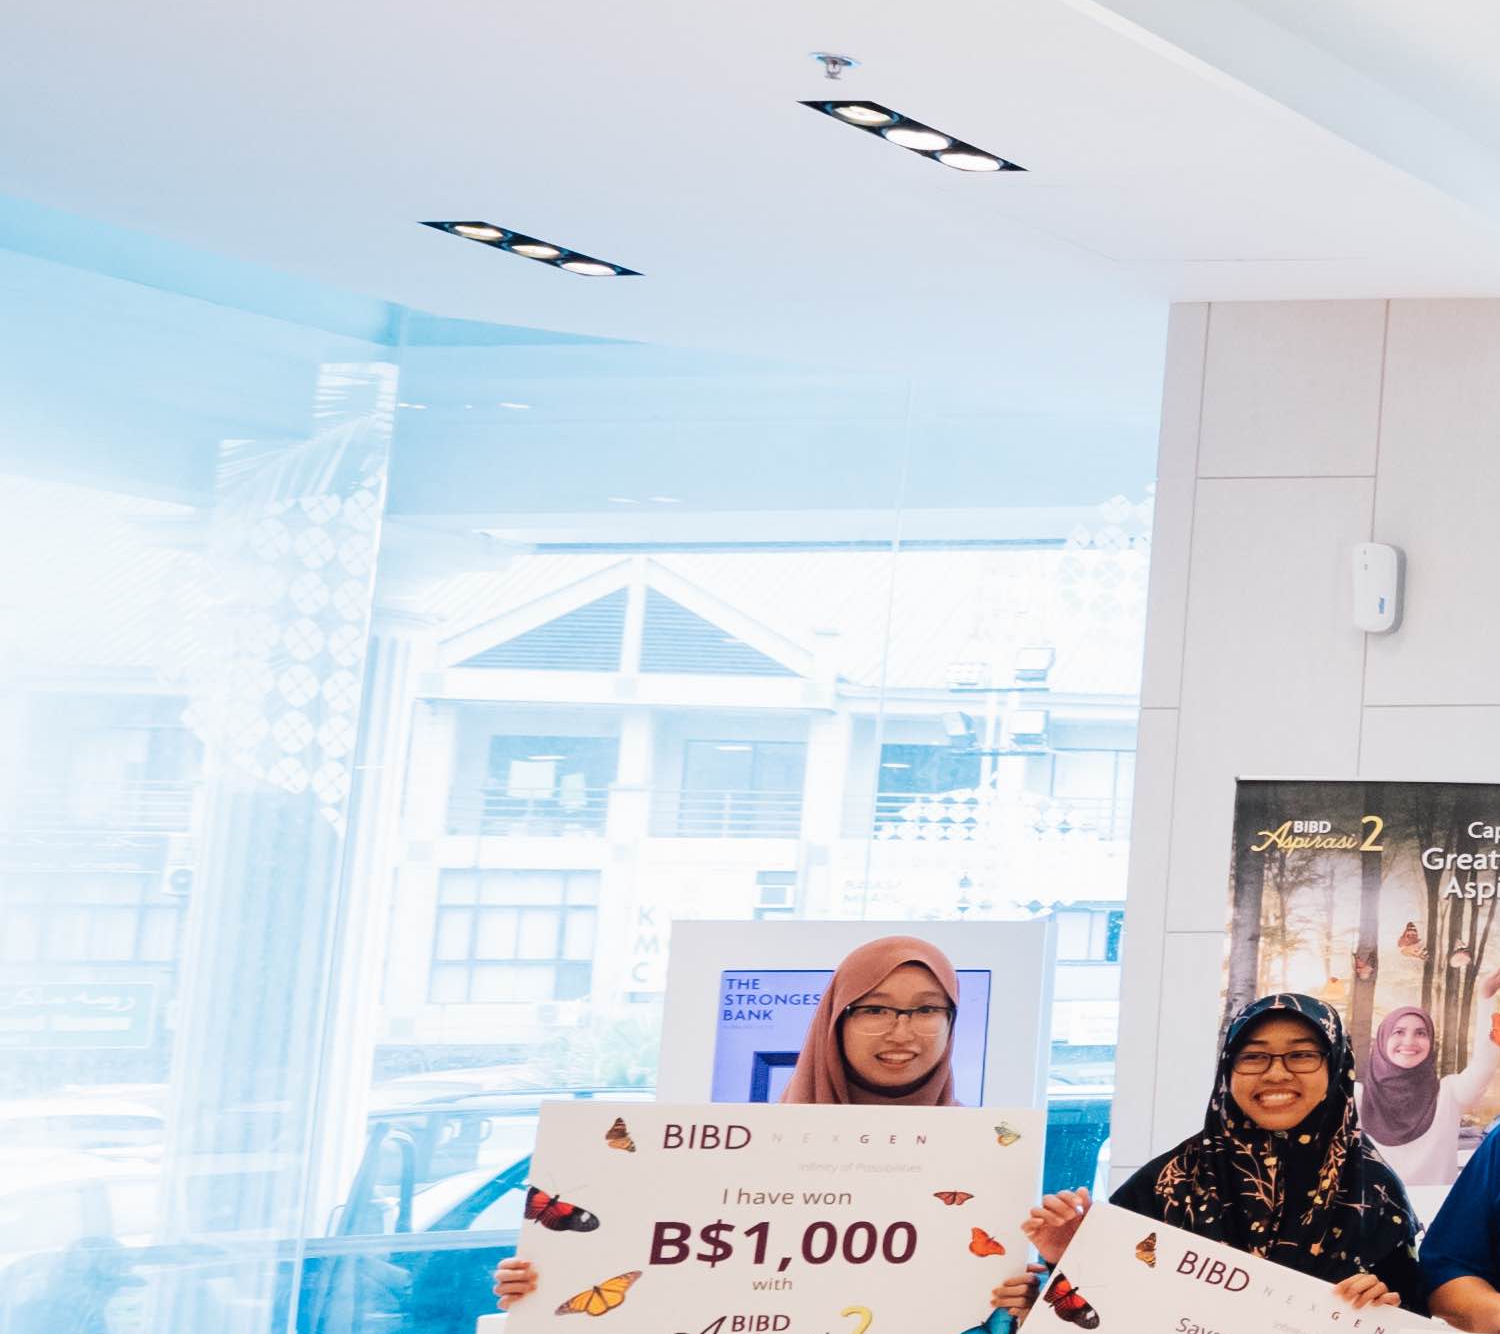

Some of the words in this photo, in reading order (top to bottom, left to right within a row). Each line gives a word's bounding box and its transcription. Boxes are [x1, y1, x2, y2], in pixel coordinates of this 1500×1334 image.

[1251, 820, 1360, 855] Aspirasi
[1360, 815, 1384, 852] 2
[1293, 820, 1331, 834] BIBD
[725, 978, 760, 990] THE
[724, 994, 821, 1006] STRONGES
[722, 1009, 773, 1021] BANK
[663, 1124, 751, 1150] BIBD
[721, 1188, 730, 1206] I
[737, 1187, 795, 1206] have
[801, 1192, 852, 1206] won
[649, 1219, 917, 1271] B$1,000
[1176, 1250, 1250, 1292] BIBD
[751, 1278, 794, 1292] with
[731, 1315, 791, 1332] BIBD
